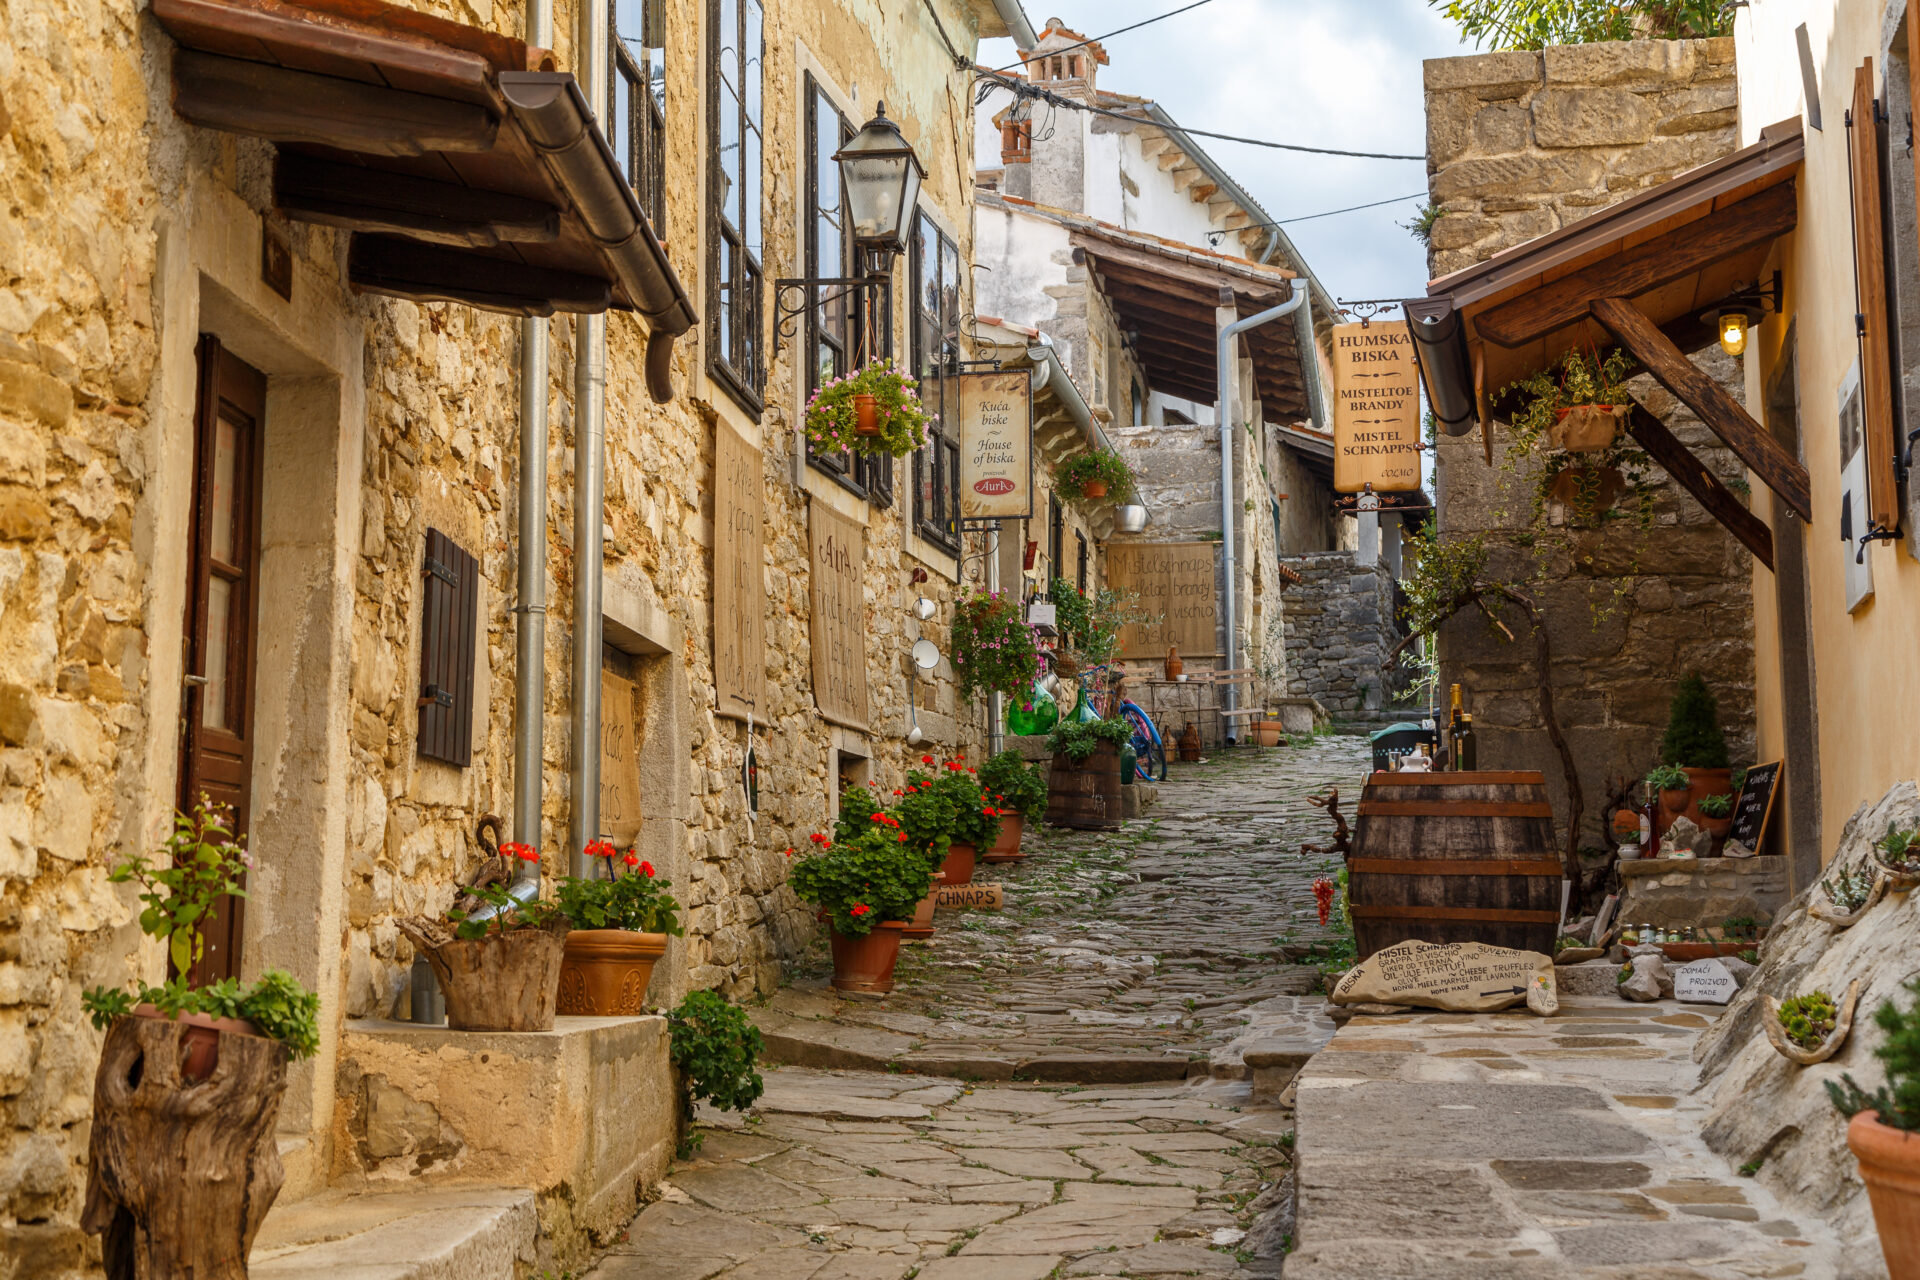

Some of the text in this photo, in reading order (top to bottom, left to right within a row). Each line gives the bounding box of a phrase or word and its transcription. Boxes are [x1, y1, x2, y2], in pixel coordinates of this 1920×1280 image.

[1340, 334, 1411, 347] HUMSKA
[1351, 350, 1400, 362] BISKA
[1341, 387, 1413, 399] MISTELTOE
[979, 401, 1010, 412] Kuća
[1350, 400, 1404, 411] BRANDY
[981, 414, 1008, 425] biske
[1353, 431, 1402, 443] MISTEL
[978, 440, 1012, 451] House
[1343, 443, 1413, 456] SCHNAPPS
[973, 452, 1016, 467] of biska
[1173, 577, 1210, 600] brandy
[1173, 604, 1214, 618] vischio
[1378, 943, 1462, 959] MISTEL SCHNAPPS
[1477, 945, 1521, 957] SUVENIRI
[1379, 949, 1459, 968] GRAPPA DI VISCHIO
[1381, 952, 1480, 973] LIKER OD TERANA VINO
[1397, 962, 1534, 985] OLIVE CHEESE TRUFFLES
[1681, 964, 1711, 974] DOMAĆI
[1340, 968, 1365, 994] BISKA
[1417, 980, 1438, 988] MIELE
[1441, 976, 1482, 986] MARMELADE
[1486, 972, 1521, 981] LAVANDA
[1689, 978, 1728, 986] PROIZVOD
[1451, 984, 1470, 992] MADE
